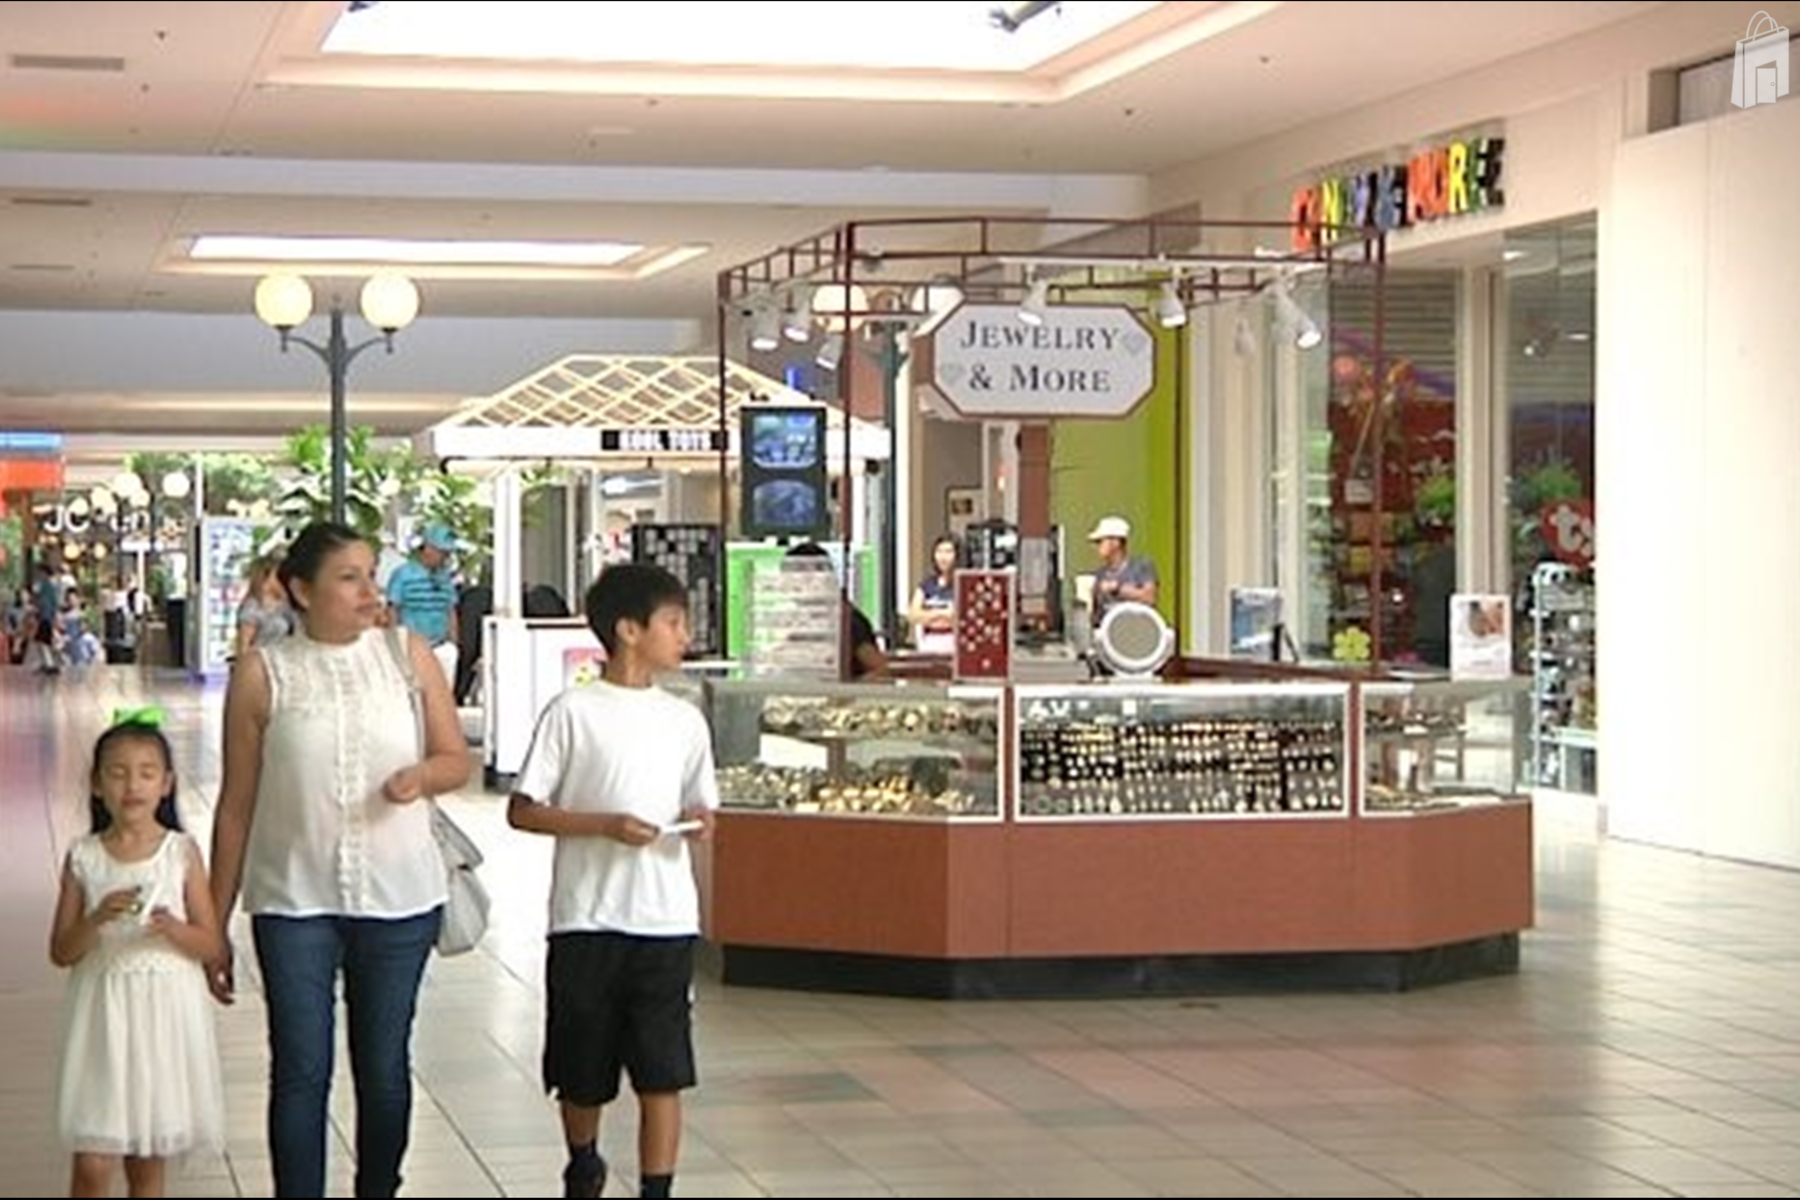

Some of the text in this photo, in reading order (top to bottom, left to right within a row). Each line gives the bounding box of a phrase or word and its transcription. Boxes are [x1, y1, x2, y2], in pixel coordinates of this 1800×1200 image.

[1407, 138, 1504, 223] MORE
[961, 320, 1120, 351] JEWELRY
[969, 364, 1111, 391] & MORE
